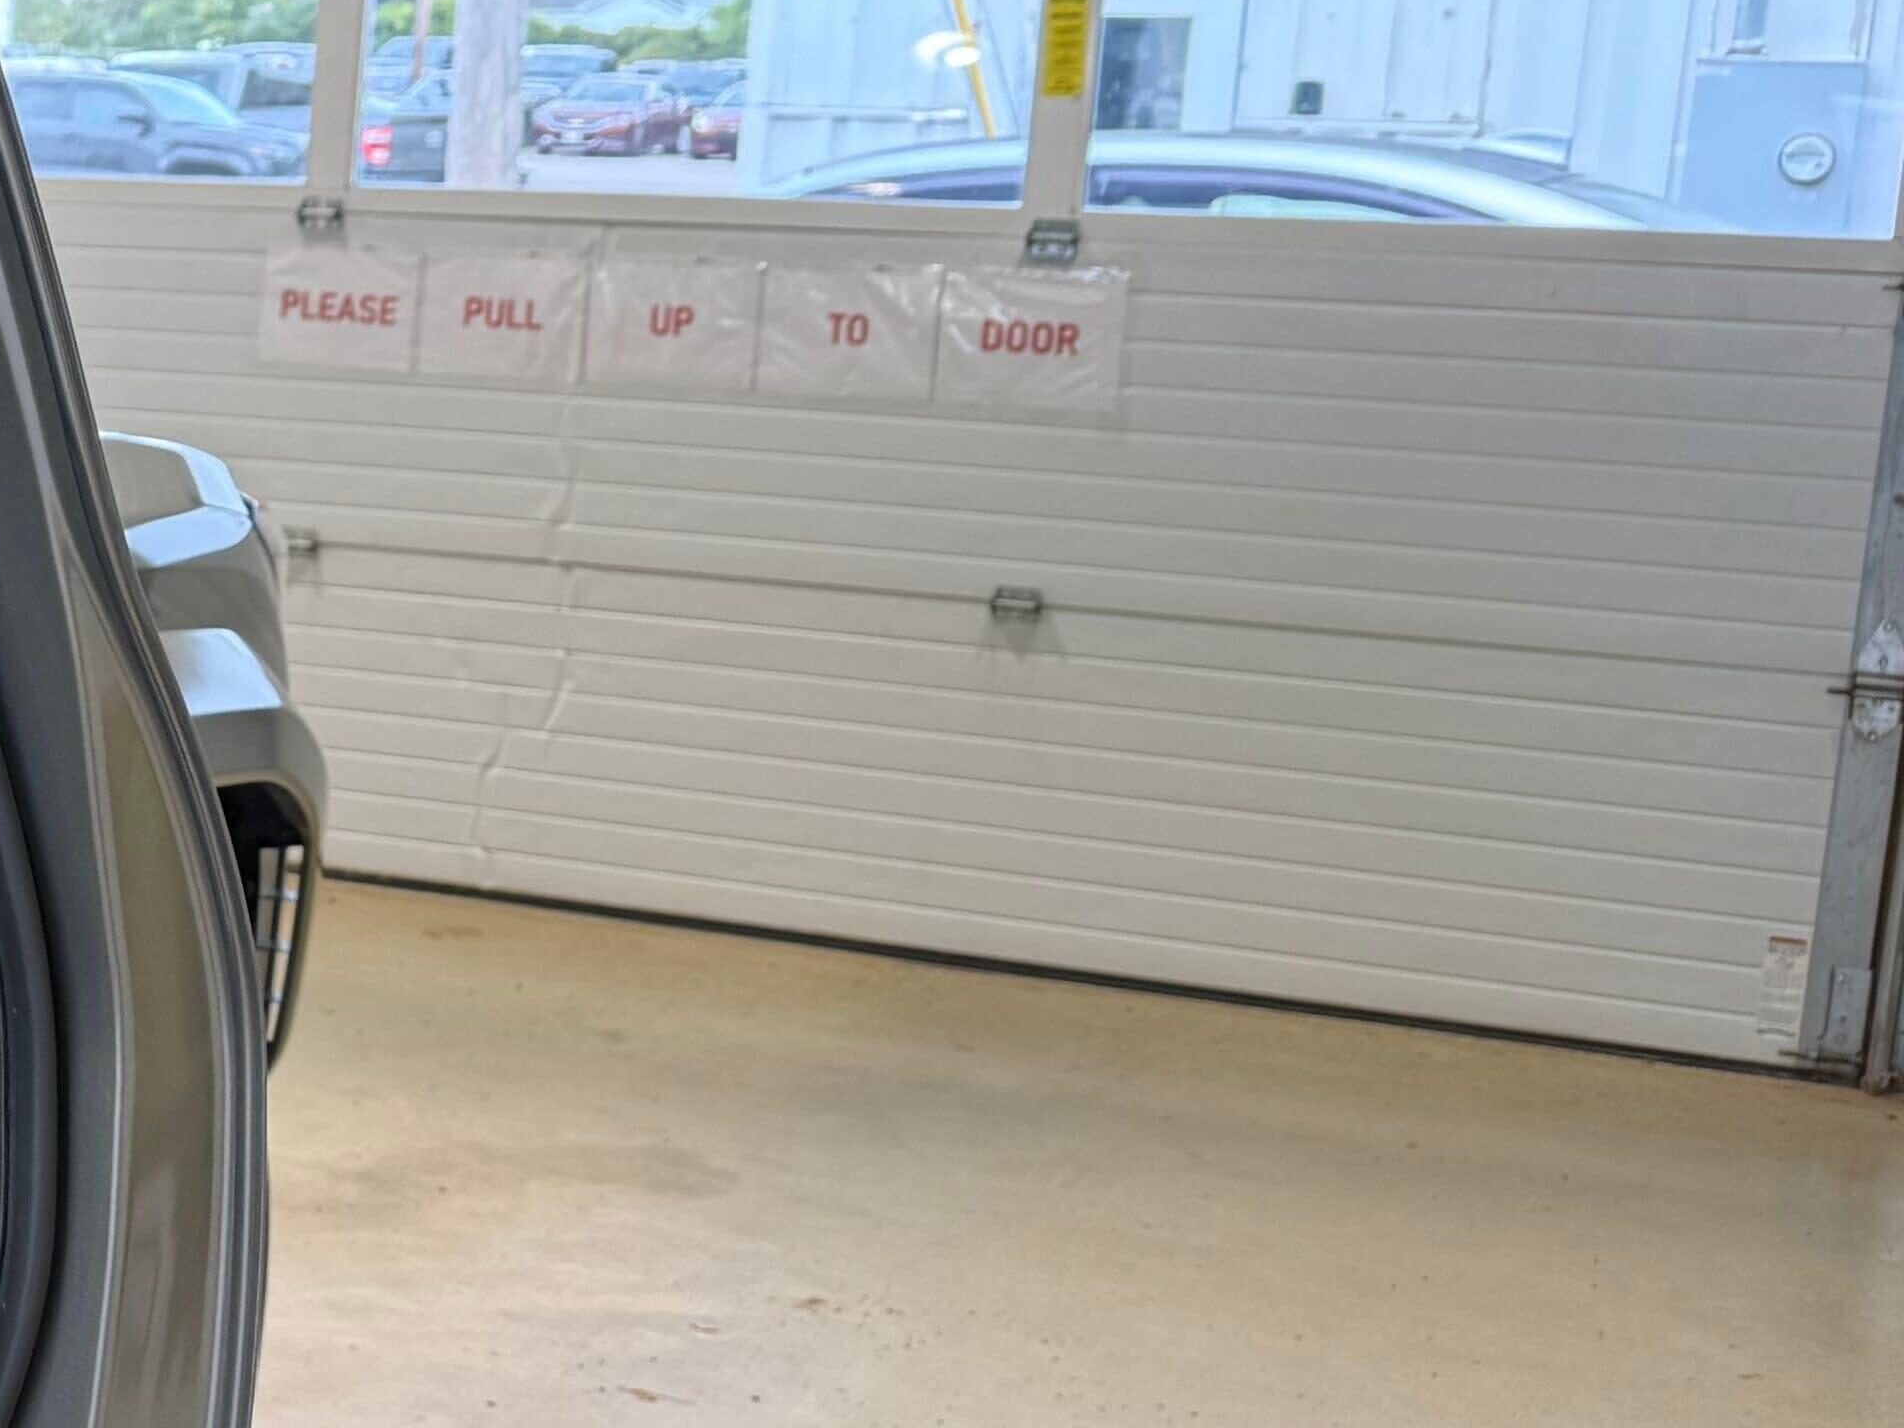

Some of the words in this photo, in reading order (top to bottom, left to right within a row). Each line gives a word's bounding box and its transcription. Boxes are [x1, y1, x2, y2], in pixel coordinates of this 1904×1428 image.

[279, 289, 398, 326] PLEASE
[462, 296, 543, 332] PULL
[650, 305, 694, 338] UP
[828, 312, 869, 346] TO
[980, 320, 1080, 356] DOOR
